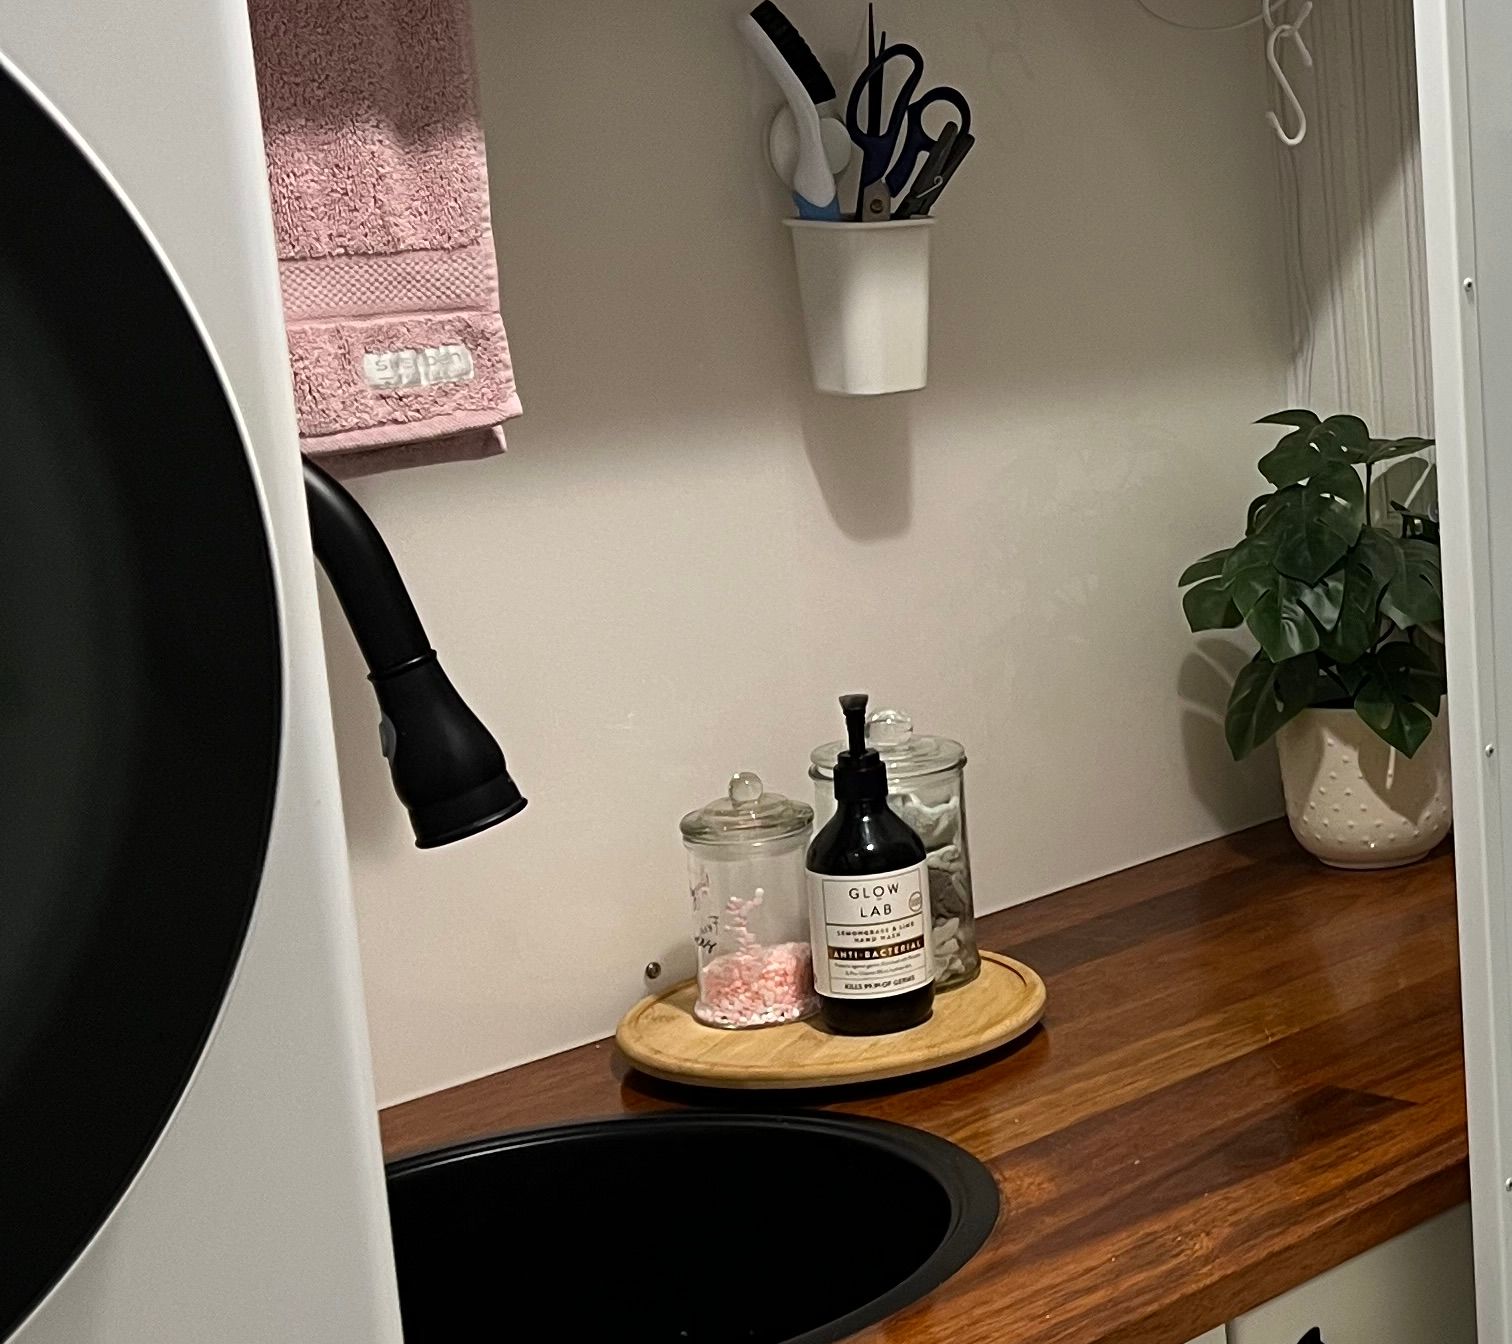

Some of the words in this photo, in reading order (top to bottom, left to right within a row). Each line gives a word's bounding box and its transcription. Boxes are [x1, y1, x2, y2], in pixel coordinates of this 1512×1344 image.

[849, 883, 899, 899] GLOW
[860, 904, 892, 918] LAB
[833, 940, 921, 959] ANTI-BACTERIAL
